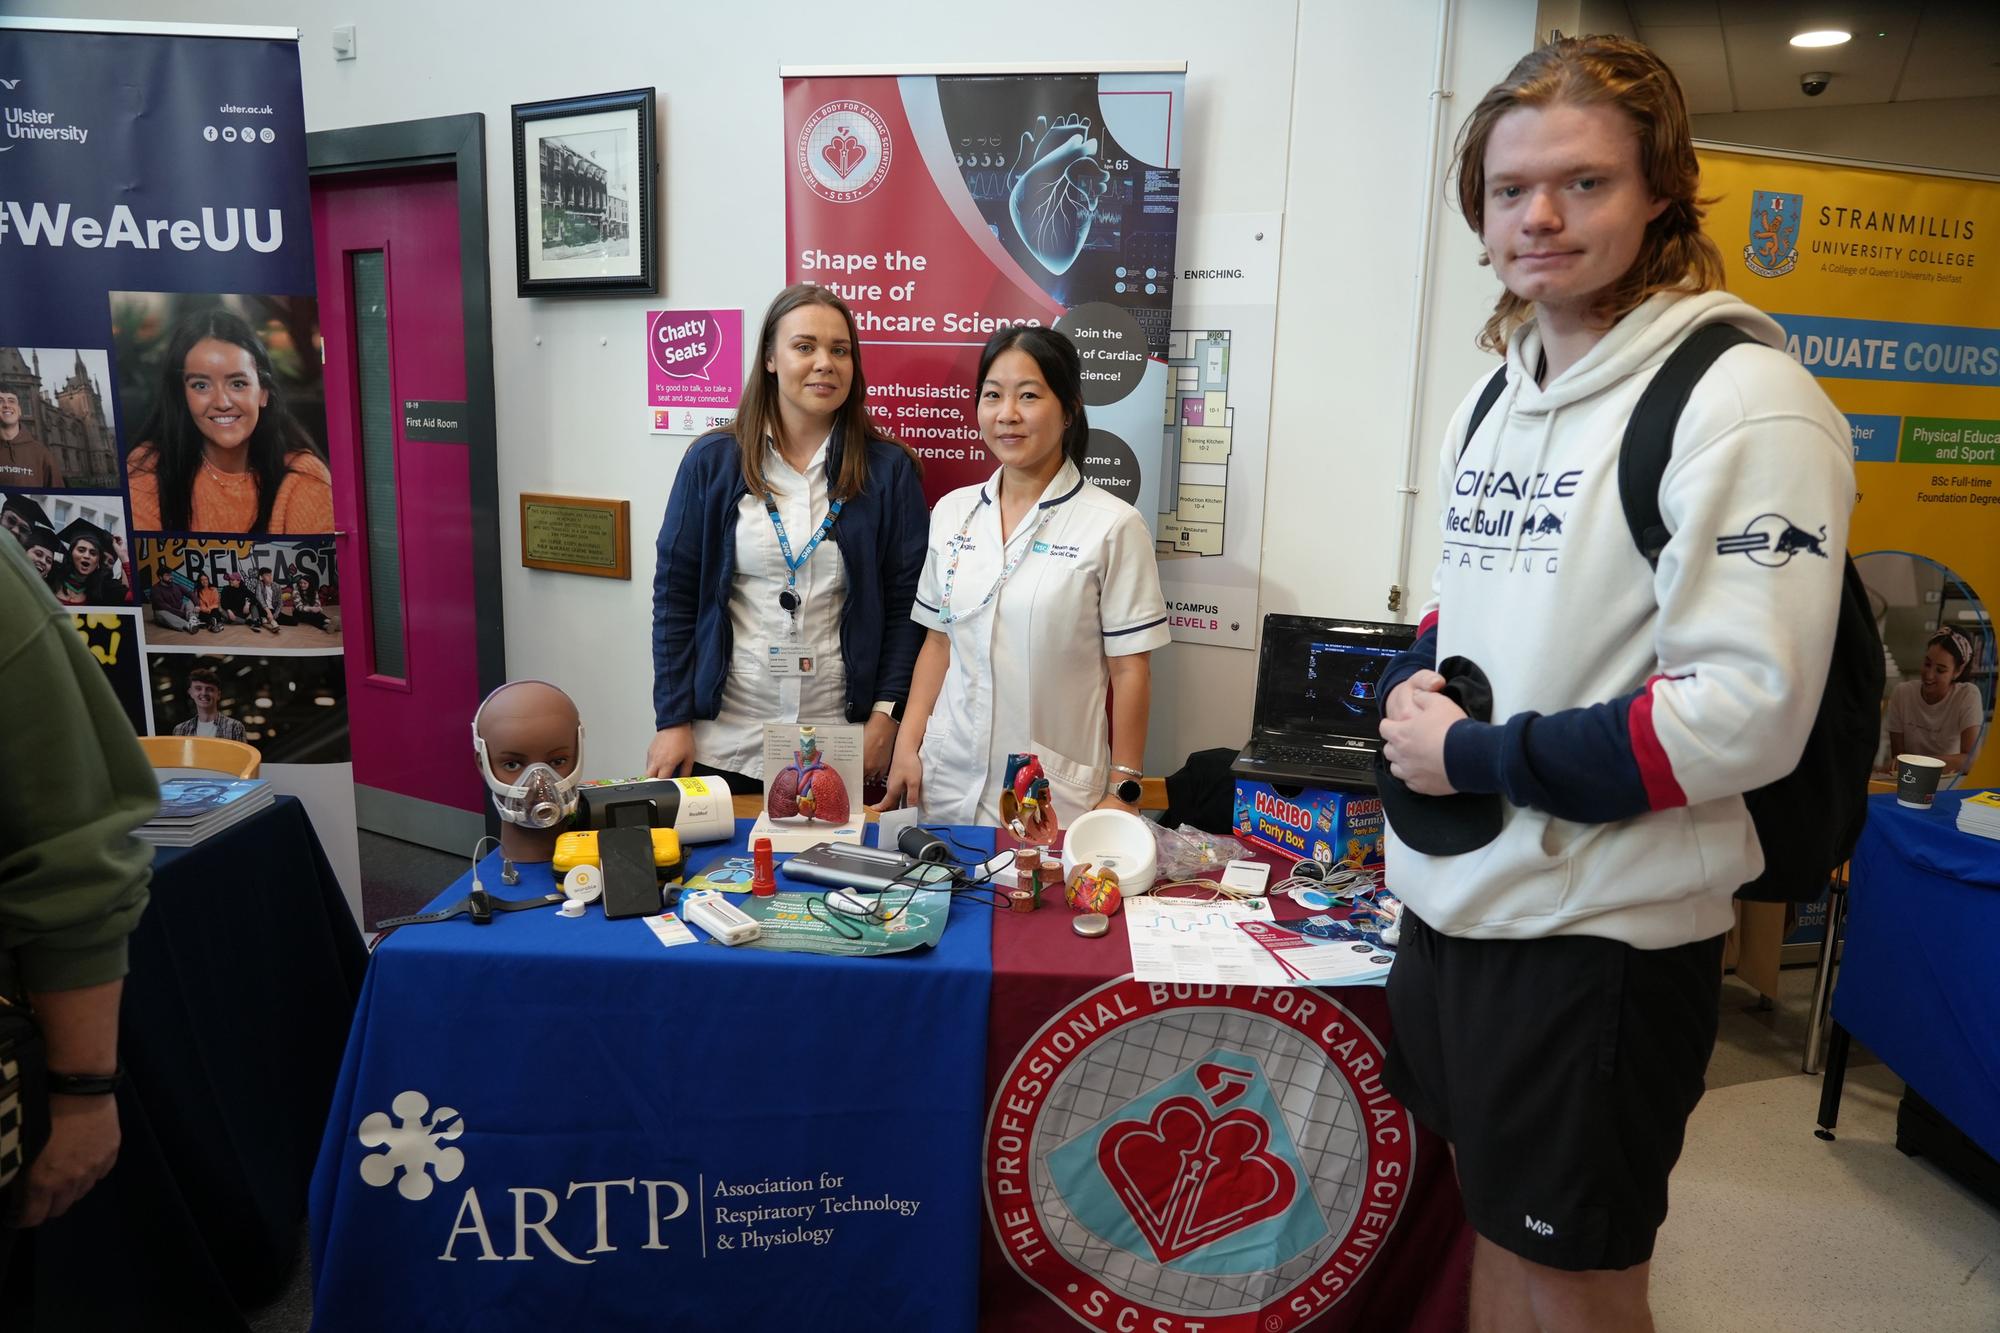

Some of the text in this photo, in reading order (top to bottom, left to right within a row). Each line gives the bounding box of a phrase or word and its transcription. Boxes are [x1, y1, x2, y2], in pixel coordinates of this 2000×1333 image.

[5, 108, 54, 125] Ulster
[220, 104, 273, 115] ulster.ac.uk
[821, 103, 841, 116] BODY
[843, 103, 859, 112] FOR
[860, 107, 886, 135] CARDIAC
[7, 125, 88, 144] University
[1115, 160, 1129, 171] 65
[829, 191, 858, 200] SCST
[1819, 206, 1975, 240] STRANMILLIS
[801, 249, 927, 274] Shape the
[1812, 240, 1975, 267] UNIVERSITY COLLEGE
[1184, 269, 1245, 280] ENRICHING.
[1821, 264, 1962, 284] A College of Queen's University Belfast
[802, 281, 915, 301] ture of
[850, 311, 936, 332] lthcare
[659, 319, 706, 343] Chatty
[1075, 328, 1123, 339] Join the
[665, 342, 707, 364] Seats
[1083, 349, 1096, 359] of
[1098, 350, 1142, 361] Cardiac
[1784, 335, 2000, 376] ADUATE COURS
[1080, 371, 1121, 382] cience!
[665, 384, 680, 393] good
[713, 385, 727, 393] take
[867, 383, 970, 399] enthusiastic
[672, 394, 683, 402] and
[684, 395, 697, 404] stay
[897, 403, 964, 421] science,
[406, 417, 458, 429] First Aid Room
[1850, 426, 1874, 440] cher
[1913, 427, 2000, 445] Physical Educa
[910, 445, 985, 460] erence in
[1084, 456, 1121, 466] ome a
[1936, 447, 1995, 463] and Sport
[1083, 475, 1132, 488] Member
[1456, 470, 1584, 501] ORACLE
[1931, 476, 1993, 488] BSc Full-time
[1917, 492, 1967, 503] Foundation
[1446, 507, 1514, 536] Red Bull
[1442, 549, 1558, 573] RACNG
[1176, 602, 1219, 615] CAMPUS
[1169, 616, 1218, 630] LEVEL B
[1255, 791, 1313, 832] HARIBO
[1346, 799, 1383, 817] HARIB
[1349, 815, 1384, 829] Starmix
[1259, 818, 1284, 843] Party
[1286, 829, 1305, 850] Box
[1354, 827, 1367, 835] Party
[1806, 903, 1827, 914] SHA
[1799, 915, 1826, 926] EDUC
[997, 982, 1401, 1319] THE PROFESSIONAL BODY FOR CARDIAC SCIENTISTS
[438, 1172, 844, 1265] ARTP Association for
[716, 1195, 920, 1226] Respiratory Technology
[717, 1225, 834, 1250] & Physiology
[1082, 1290, 1205, 1333] SCS
